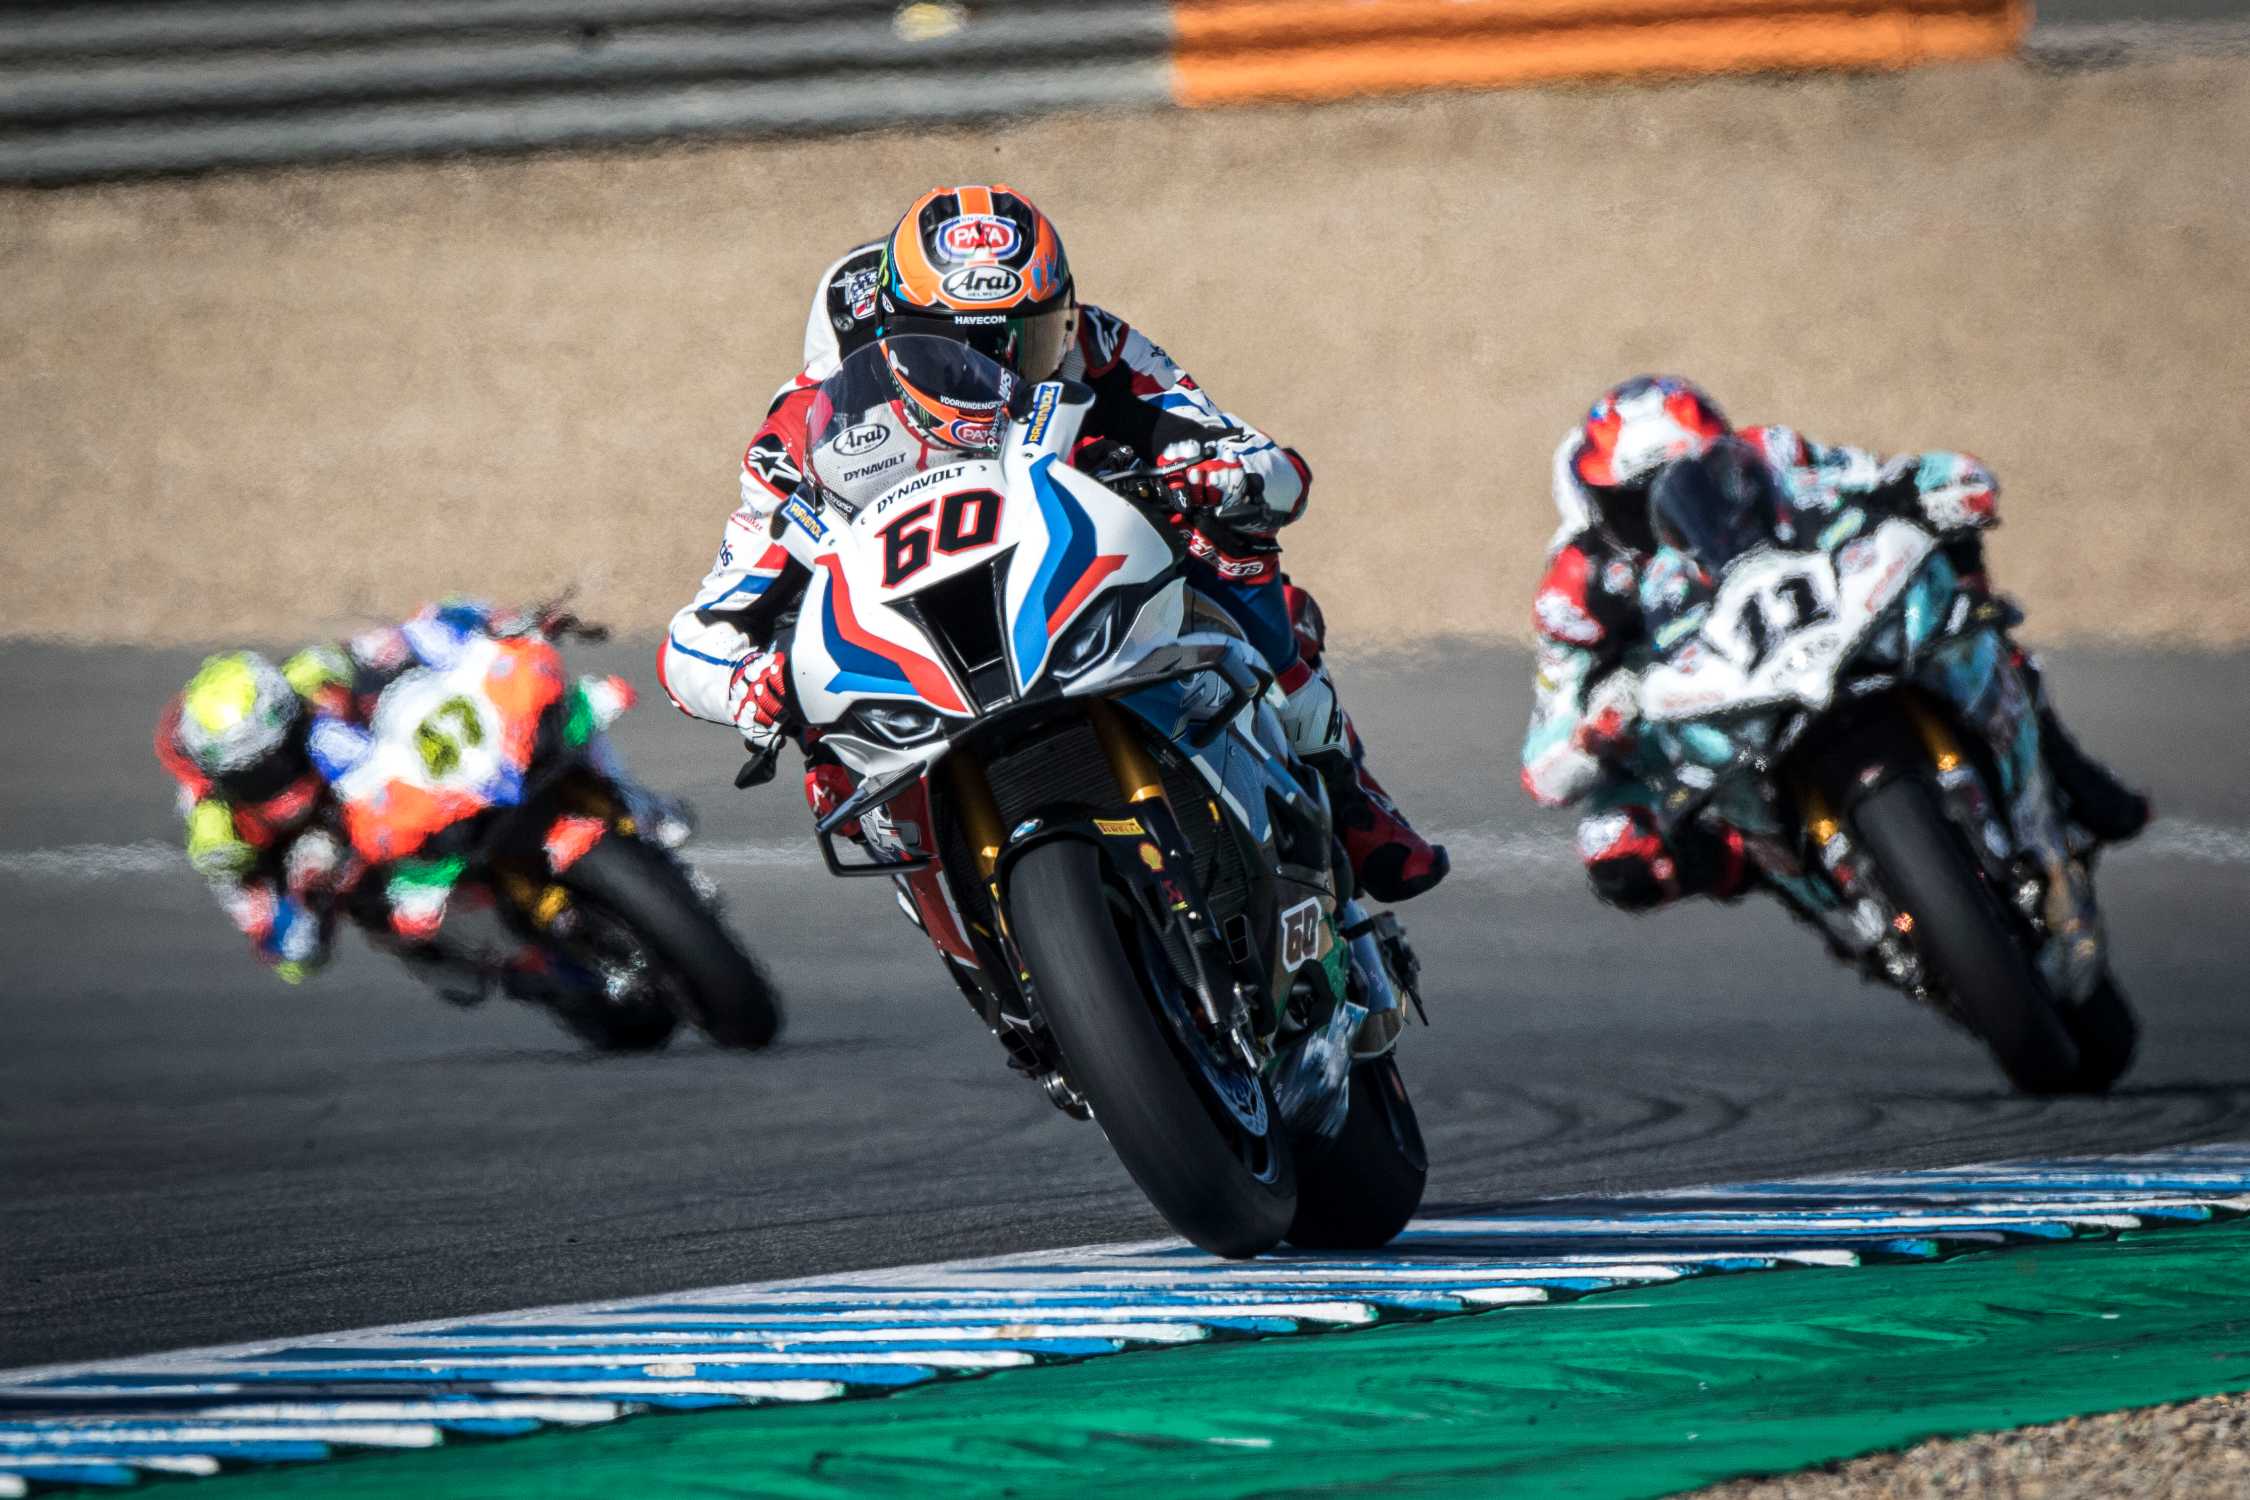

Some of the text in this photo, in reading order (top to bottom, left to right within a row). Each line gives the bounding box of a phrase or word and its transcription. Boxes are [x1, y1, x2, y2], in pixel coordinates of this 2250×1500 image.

[948, 270, 1010, 291] Arai
[954, 315, 1007, 325] HAVECON
[839, 425, 883, 449] Arai
[843, 452, 907, 482] DYNAVOLT
[877, 466, 965, 514] DYNAVOLT
[875, 488, 1005, 588] 60
[1283, 901, 1319, 967] 60
